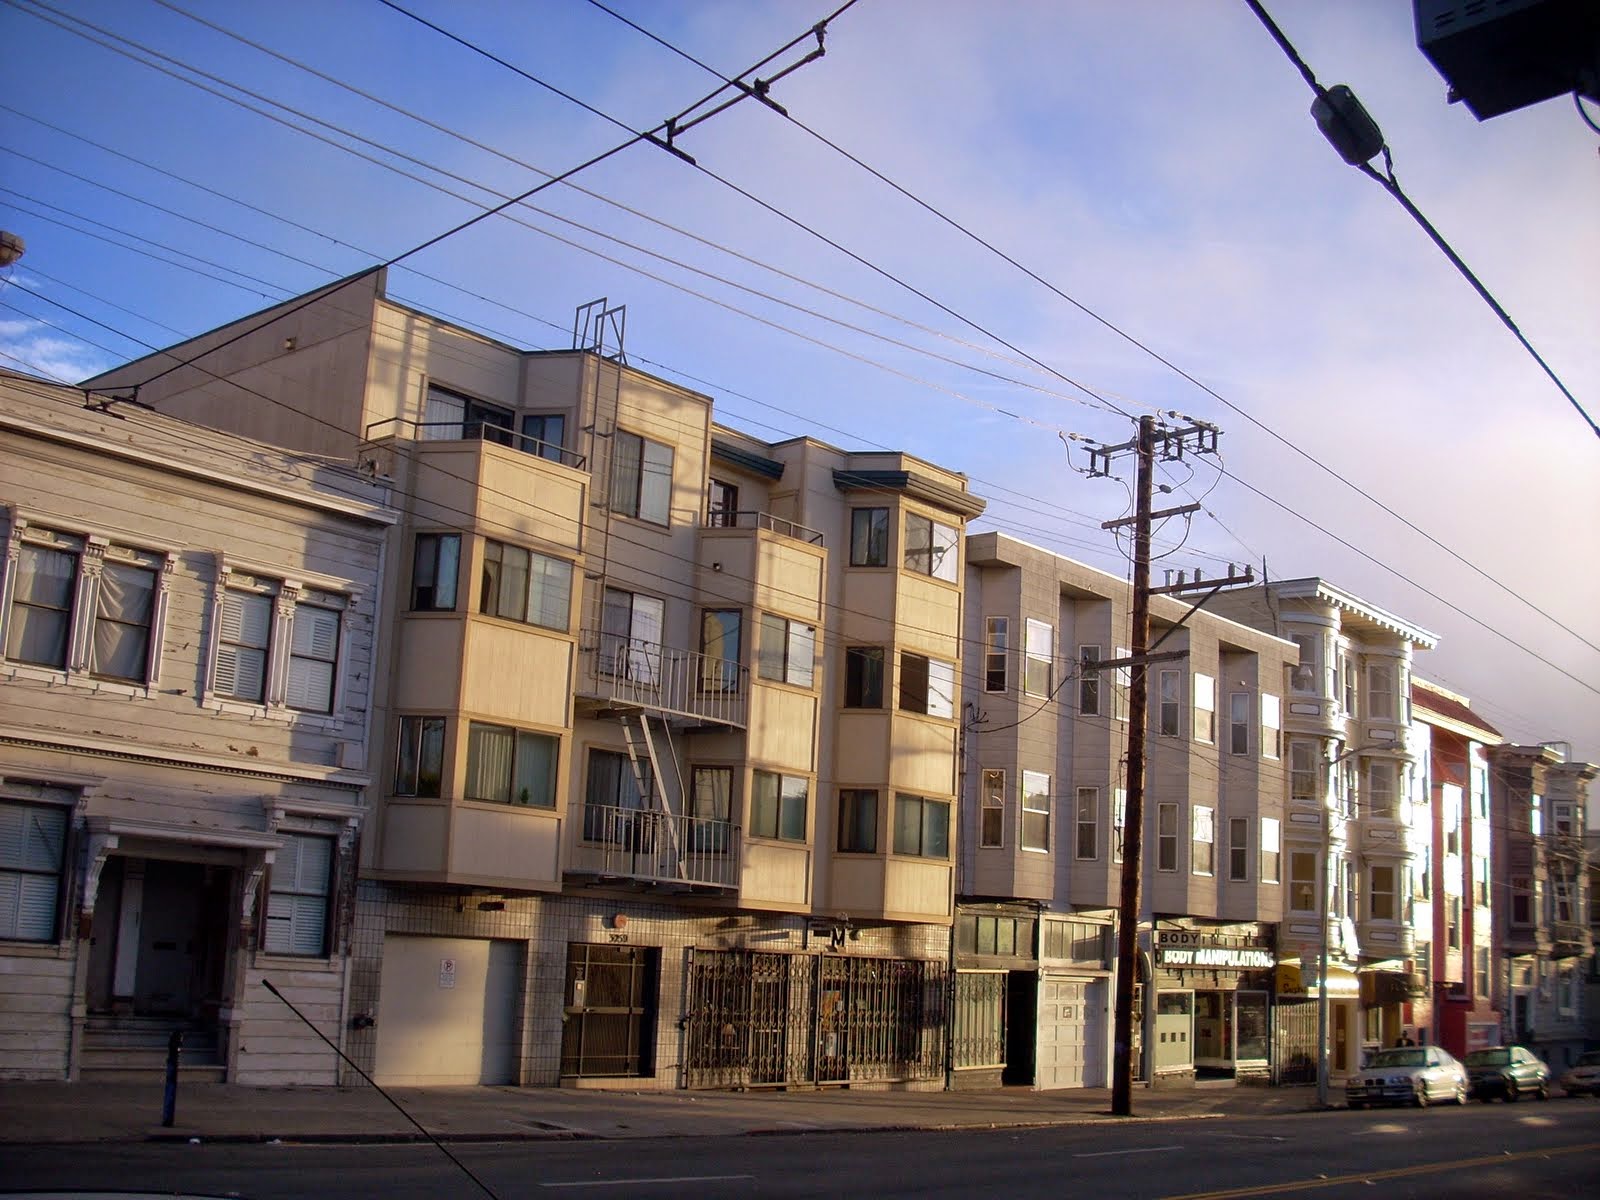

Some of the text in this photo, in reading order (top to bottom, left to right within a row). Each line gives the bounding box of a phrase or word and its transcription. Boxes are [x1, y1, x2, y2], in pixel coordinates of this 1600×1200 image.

[608, 933, 628, 943] 3259
[1160, 933, 1198, 944] BODY
[1164, 949, 1274, 968] BODY MANIPULATIONS
